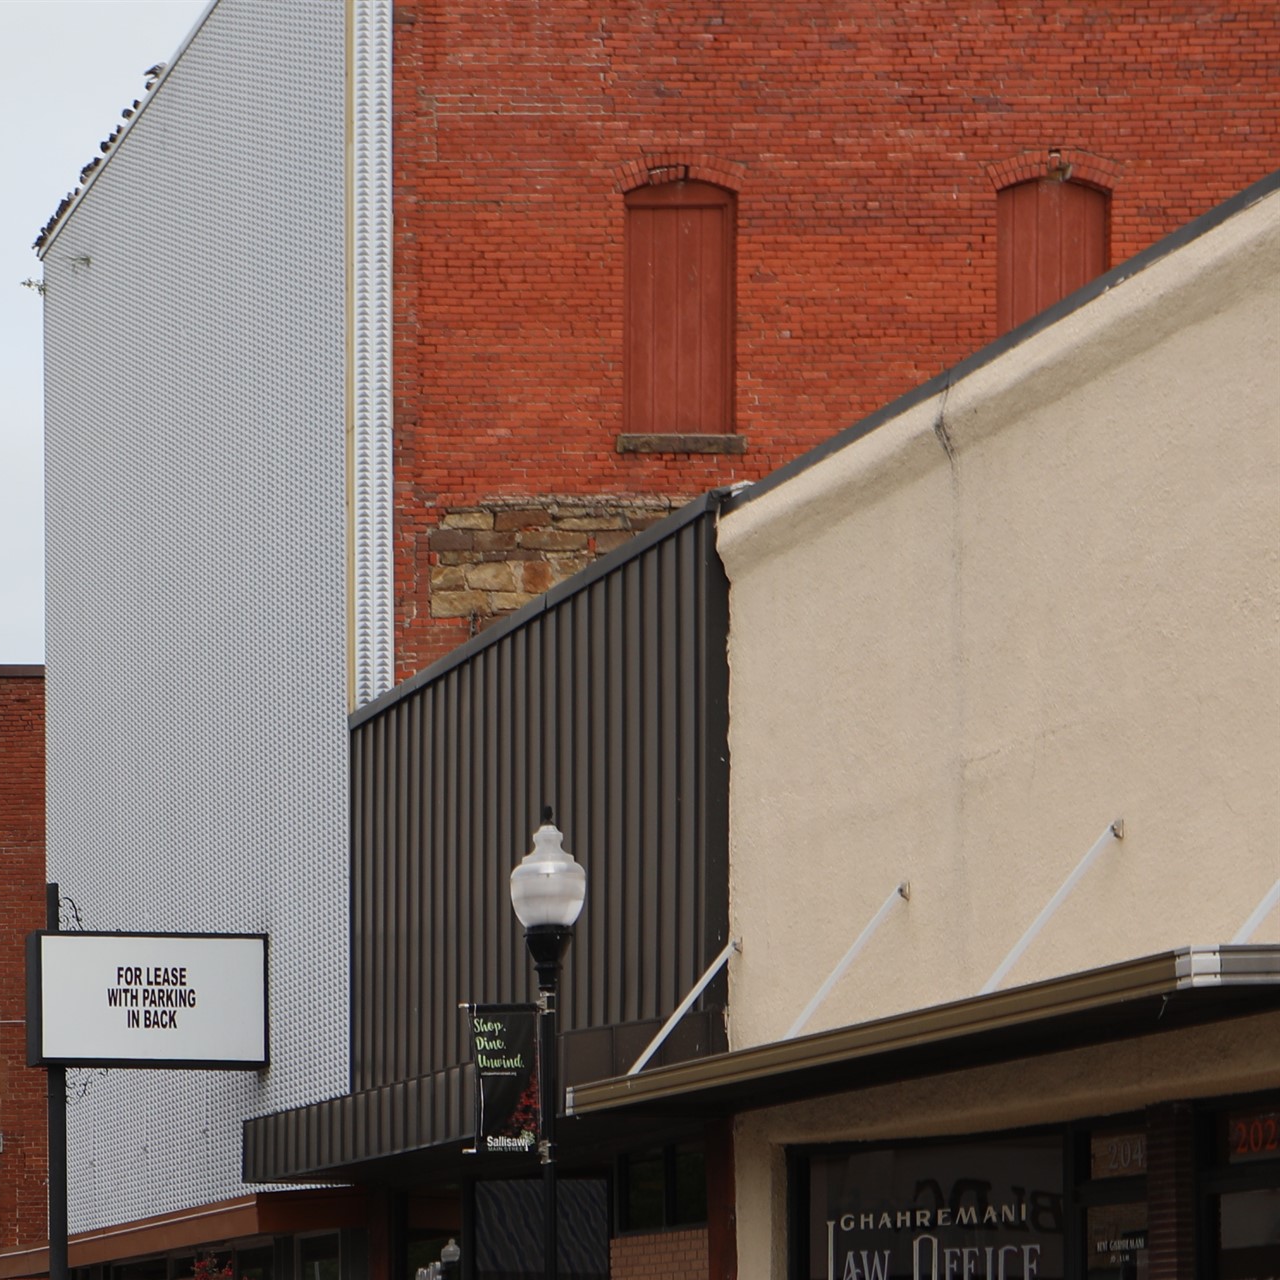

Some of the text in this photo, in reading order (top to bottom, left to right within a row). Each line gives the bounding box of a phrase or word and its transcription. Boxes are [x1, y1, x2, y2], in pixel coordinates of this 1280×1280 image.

[117, 966, 187, 986] FOR LEASE
[107, 988, 196, 1008] WITH PARKING
[127, 1009, 177, 1029] IN BACK
[473, 1018, 507, 1036] Shop.
[475, 1036, 507, 1050] Dine.
[477, 1053, 525, 1069] Unwind.
[486, 1135, 526, 1147] Sallisaw
[1235, 1119, 1277, 1153] 202
[1108, 1138, 1143, 1169] 204
[840, 1203, 1027, 1232] GHAHREMANI
